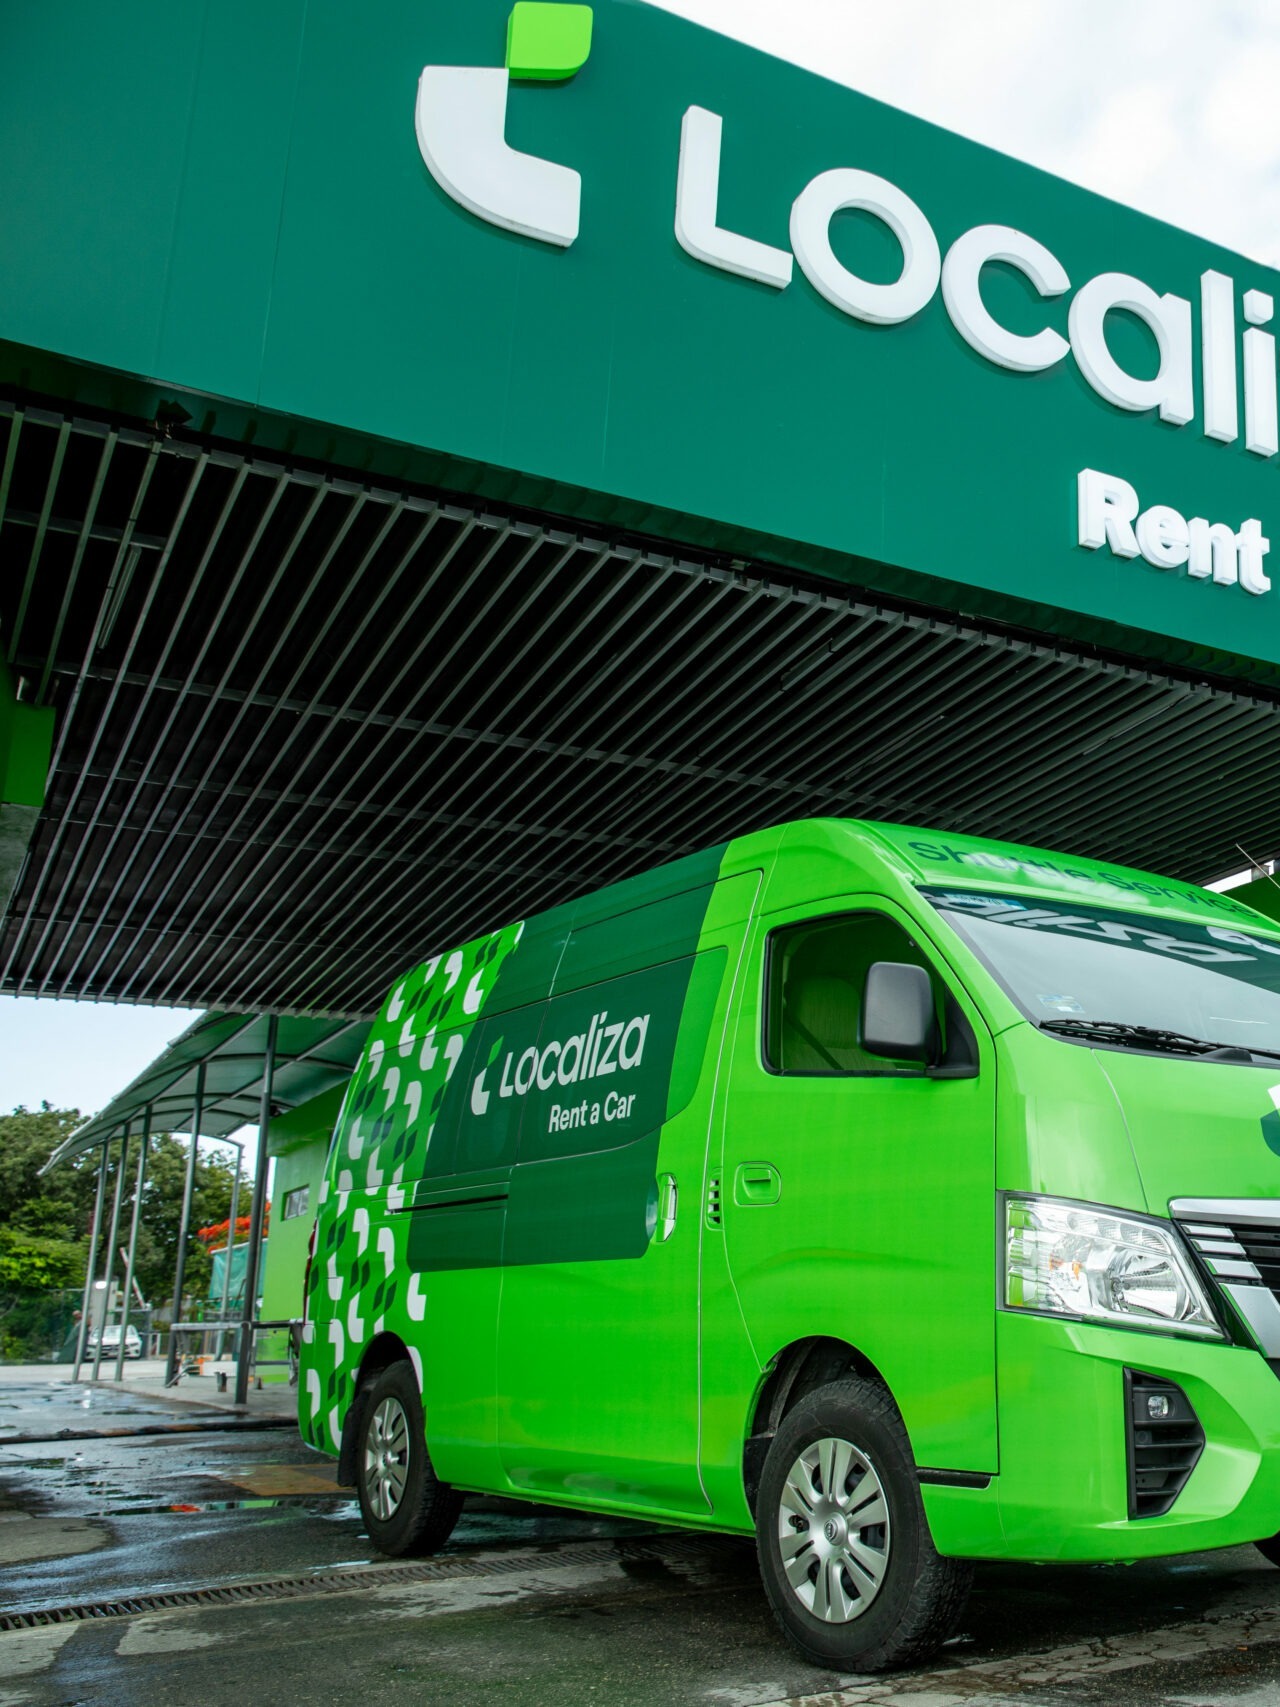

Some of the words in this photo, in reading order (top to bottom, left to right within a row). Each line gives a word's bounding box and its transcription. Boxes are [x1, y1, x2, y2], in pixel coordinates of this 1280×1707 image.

[1078, 468, 1271, 595] Rent
[1096, 871, 1259, 918] Service
[499, 1011, 651, 1098] Localiza
[548, 1100, 588, 1133] Rent
[589, 1101, 600, 1125] a
[603, 1091, 637, 1122] Car
